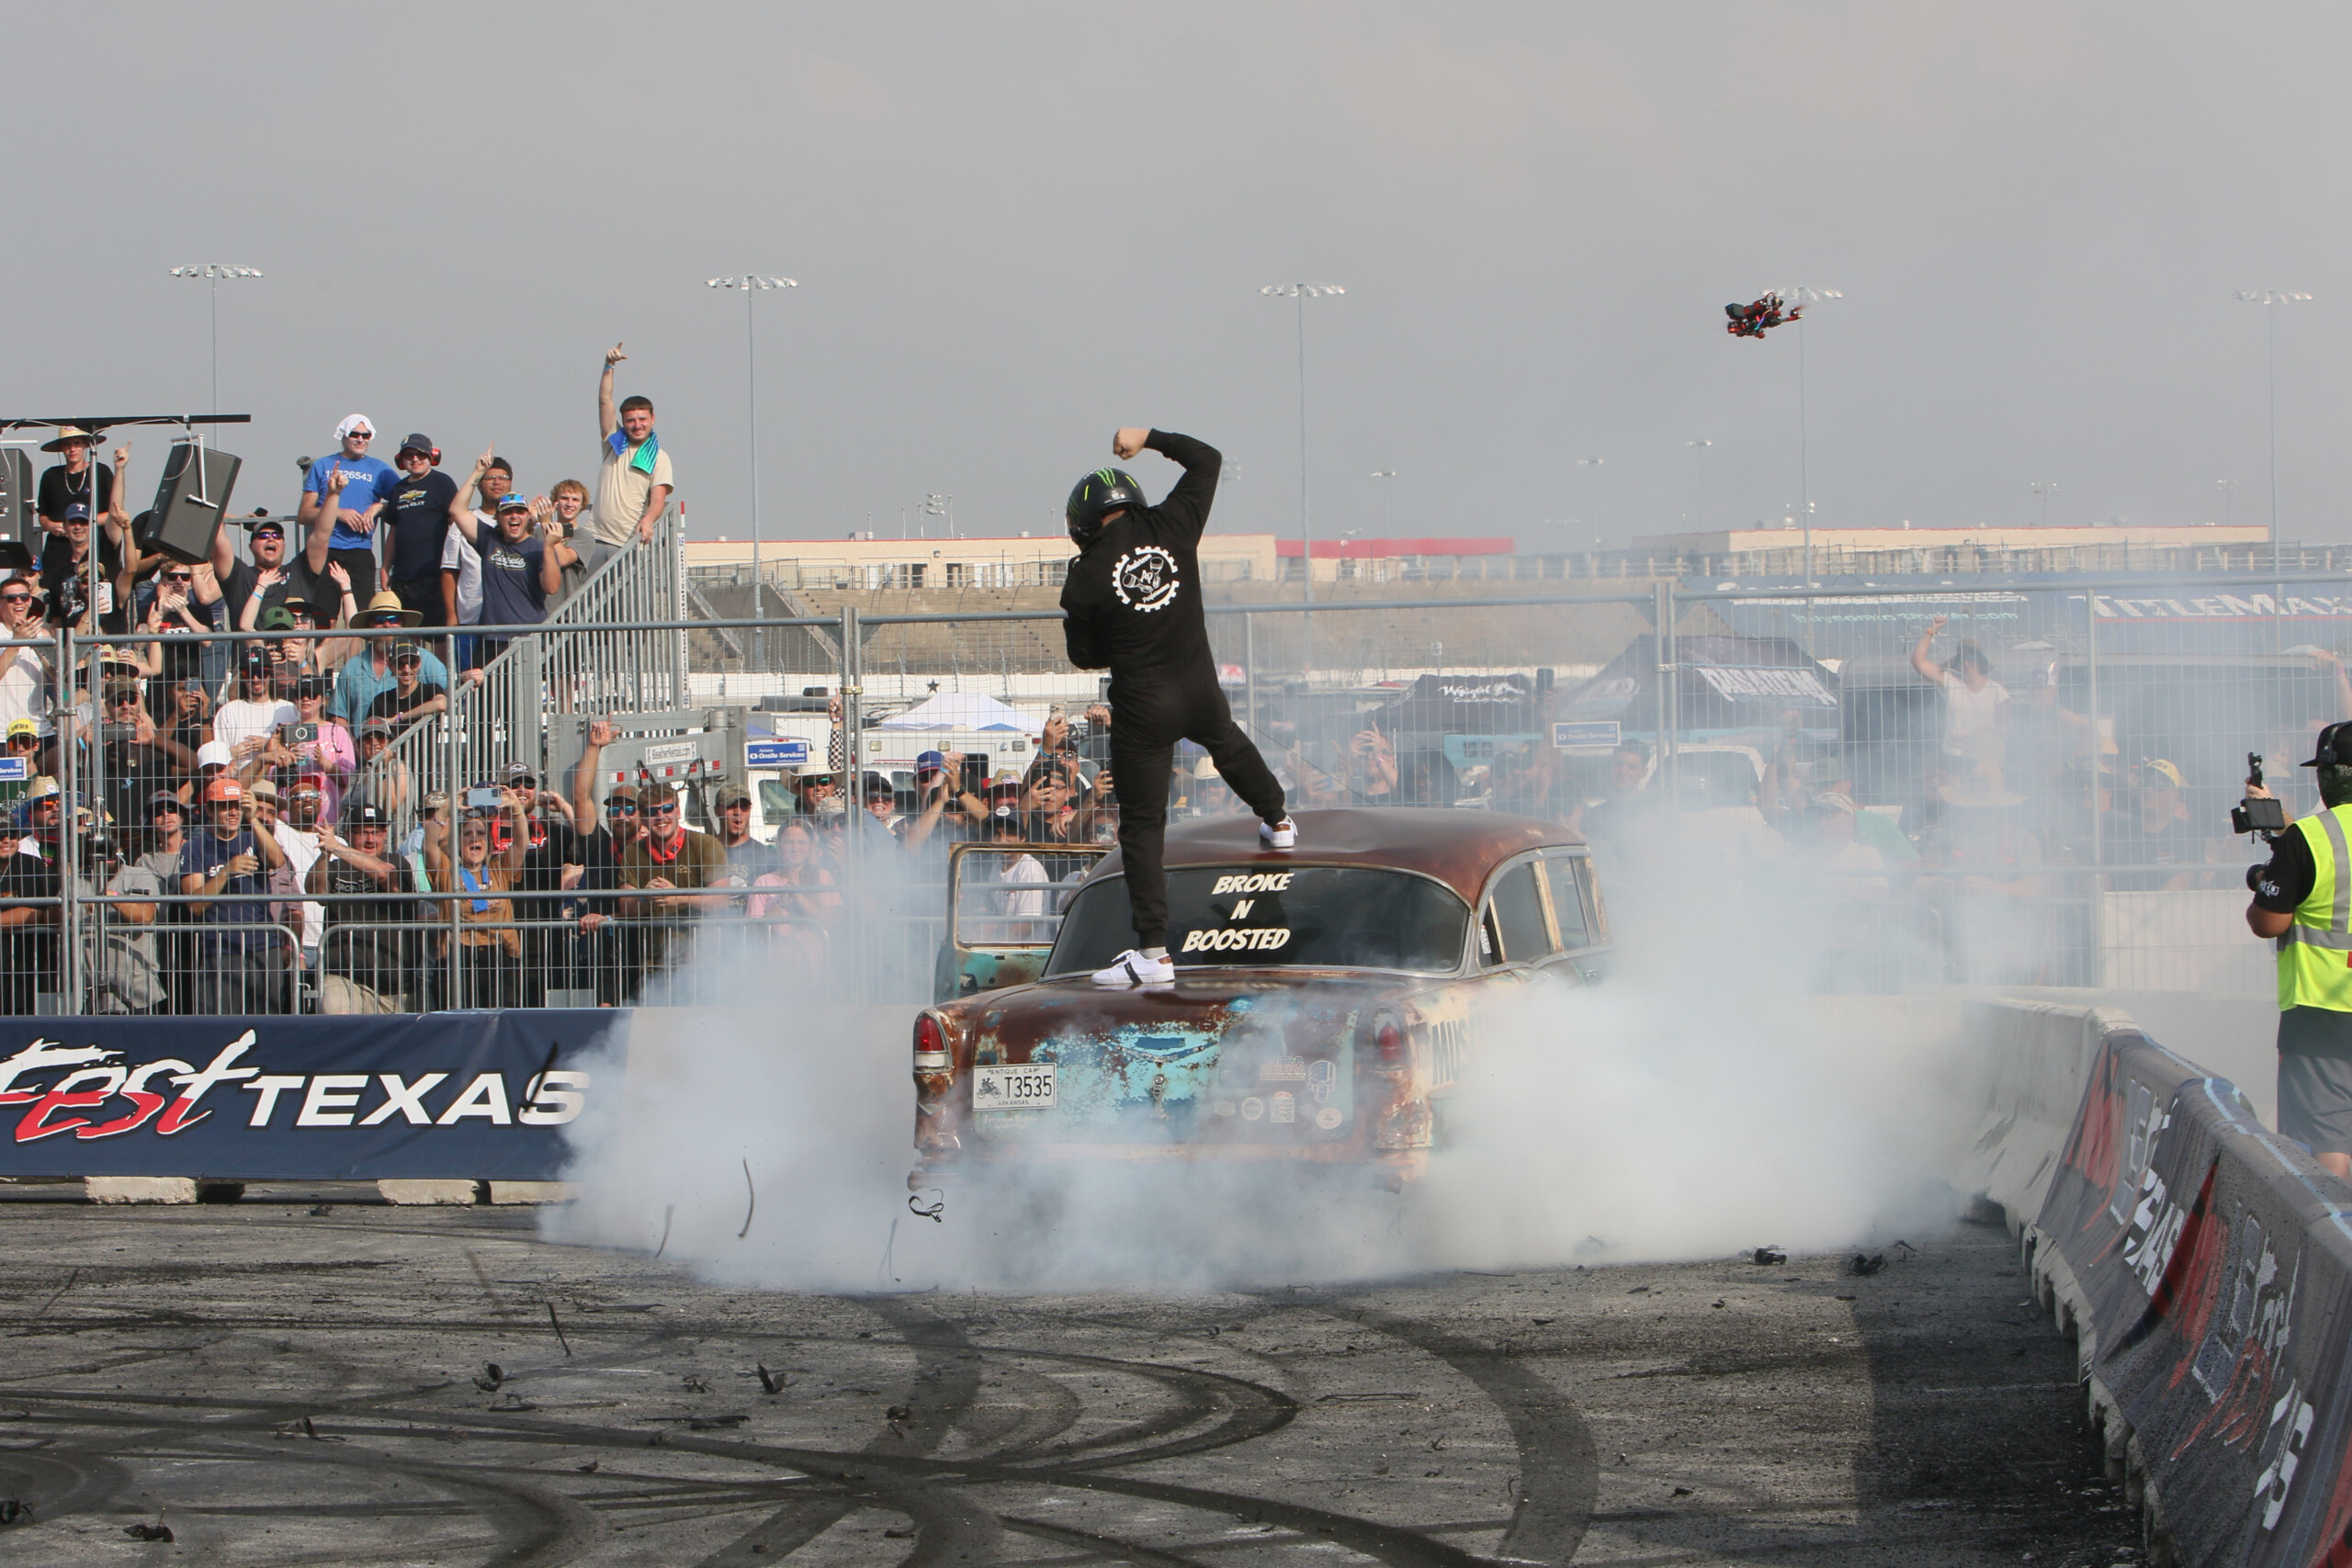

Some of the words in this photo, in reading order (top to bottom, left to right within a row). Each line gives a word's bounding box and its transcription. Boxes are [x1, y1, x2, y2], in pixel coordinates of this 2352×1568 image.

[1211, 873, 1295, 895] BROKE
[1229, 899, 1255, 919] N
[1181, 928, 1291, 953] BOOSTED
[242, 1070, 592, 1127] TEXAS
[1004, 1075, 1053, 1099] T3535
